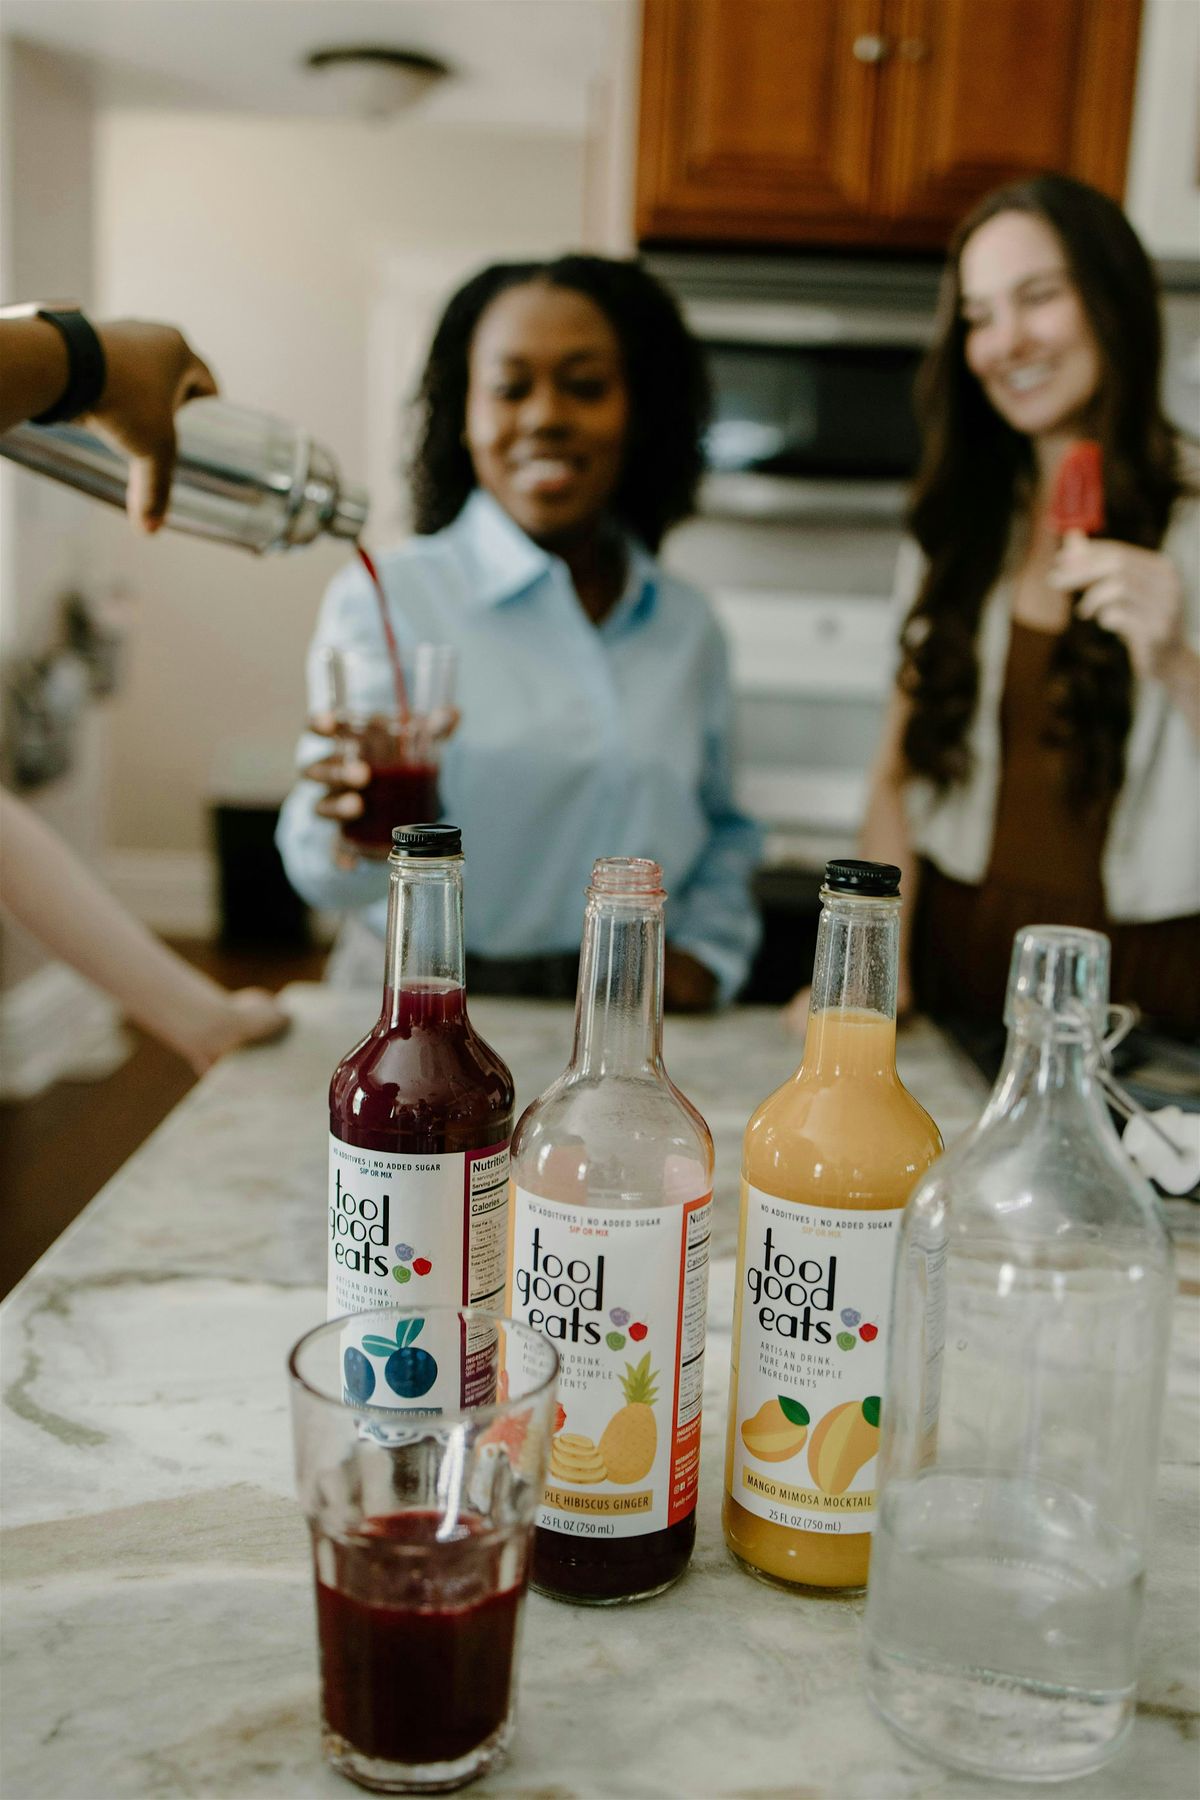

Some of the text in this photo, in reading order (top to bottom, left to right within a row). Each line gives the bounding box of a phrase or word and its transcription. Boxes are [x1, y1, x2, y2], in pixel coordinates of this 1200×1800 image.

[340, 1151, 366, 1166] ADDITIVES
[373, 1160, 384, 1168] NO
[386, 1162, 412, 1171] ADDED
[415, 1163, 441, 1172] SUGAR
[360, 1167, 369, 1175] SIP
[380, 1170, 393, 1180] MIX
[472, 1198, 500, 1213] Calories
[528, 1204, 538, 1214] NO
[539, 1208, 577, 1224] ADDITIVES
[587, 1217, 600, 1226] NO
[602, 1218, 632, 1228] ADDED
[634, 1218, 661, 1228] SUGAR
[761, 1204, 770, 1213] NO
[771, 1208, 810, 1224] ADDITIVES
[820, 1219, 832, 1228] NO
[836, 1221, 864, 1230] ADDED
[868, 1221, 893, 1230] SUGAR
[330, 1194, 390, 1246] good
[569, 1225, 609, 1237] SIP OR MIX
[335, 1242, 389, 1276] eats
[516, 1256, 604, 1312] good
[747, 1256, 837, 1312] good
[352, 1294, 366, 1304] AND
[528, 1307, 602, 1345] eats
[758, 1306, 832, 1344] eats
[760, 1342, 796, 1360] ARTISAN
[576, 1368, 613, 1380] SIMPLE
[759, 1365, 817, 1389] INGREDIENTS
[760, 1353, 843, 1380] PURE AND SIMPLE
[544, 1490, 649, 1510] PLE HIBISCUS GINGER
[746, 1474, 872, 1508] MANGO MIMOSA MOCKTAIL
[542, 1514, 615, 1535] 25 FL OZ (750 mL)
[768, 1509, 842, 1532] 25 FL OZ (750 mL)
